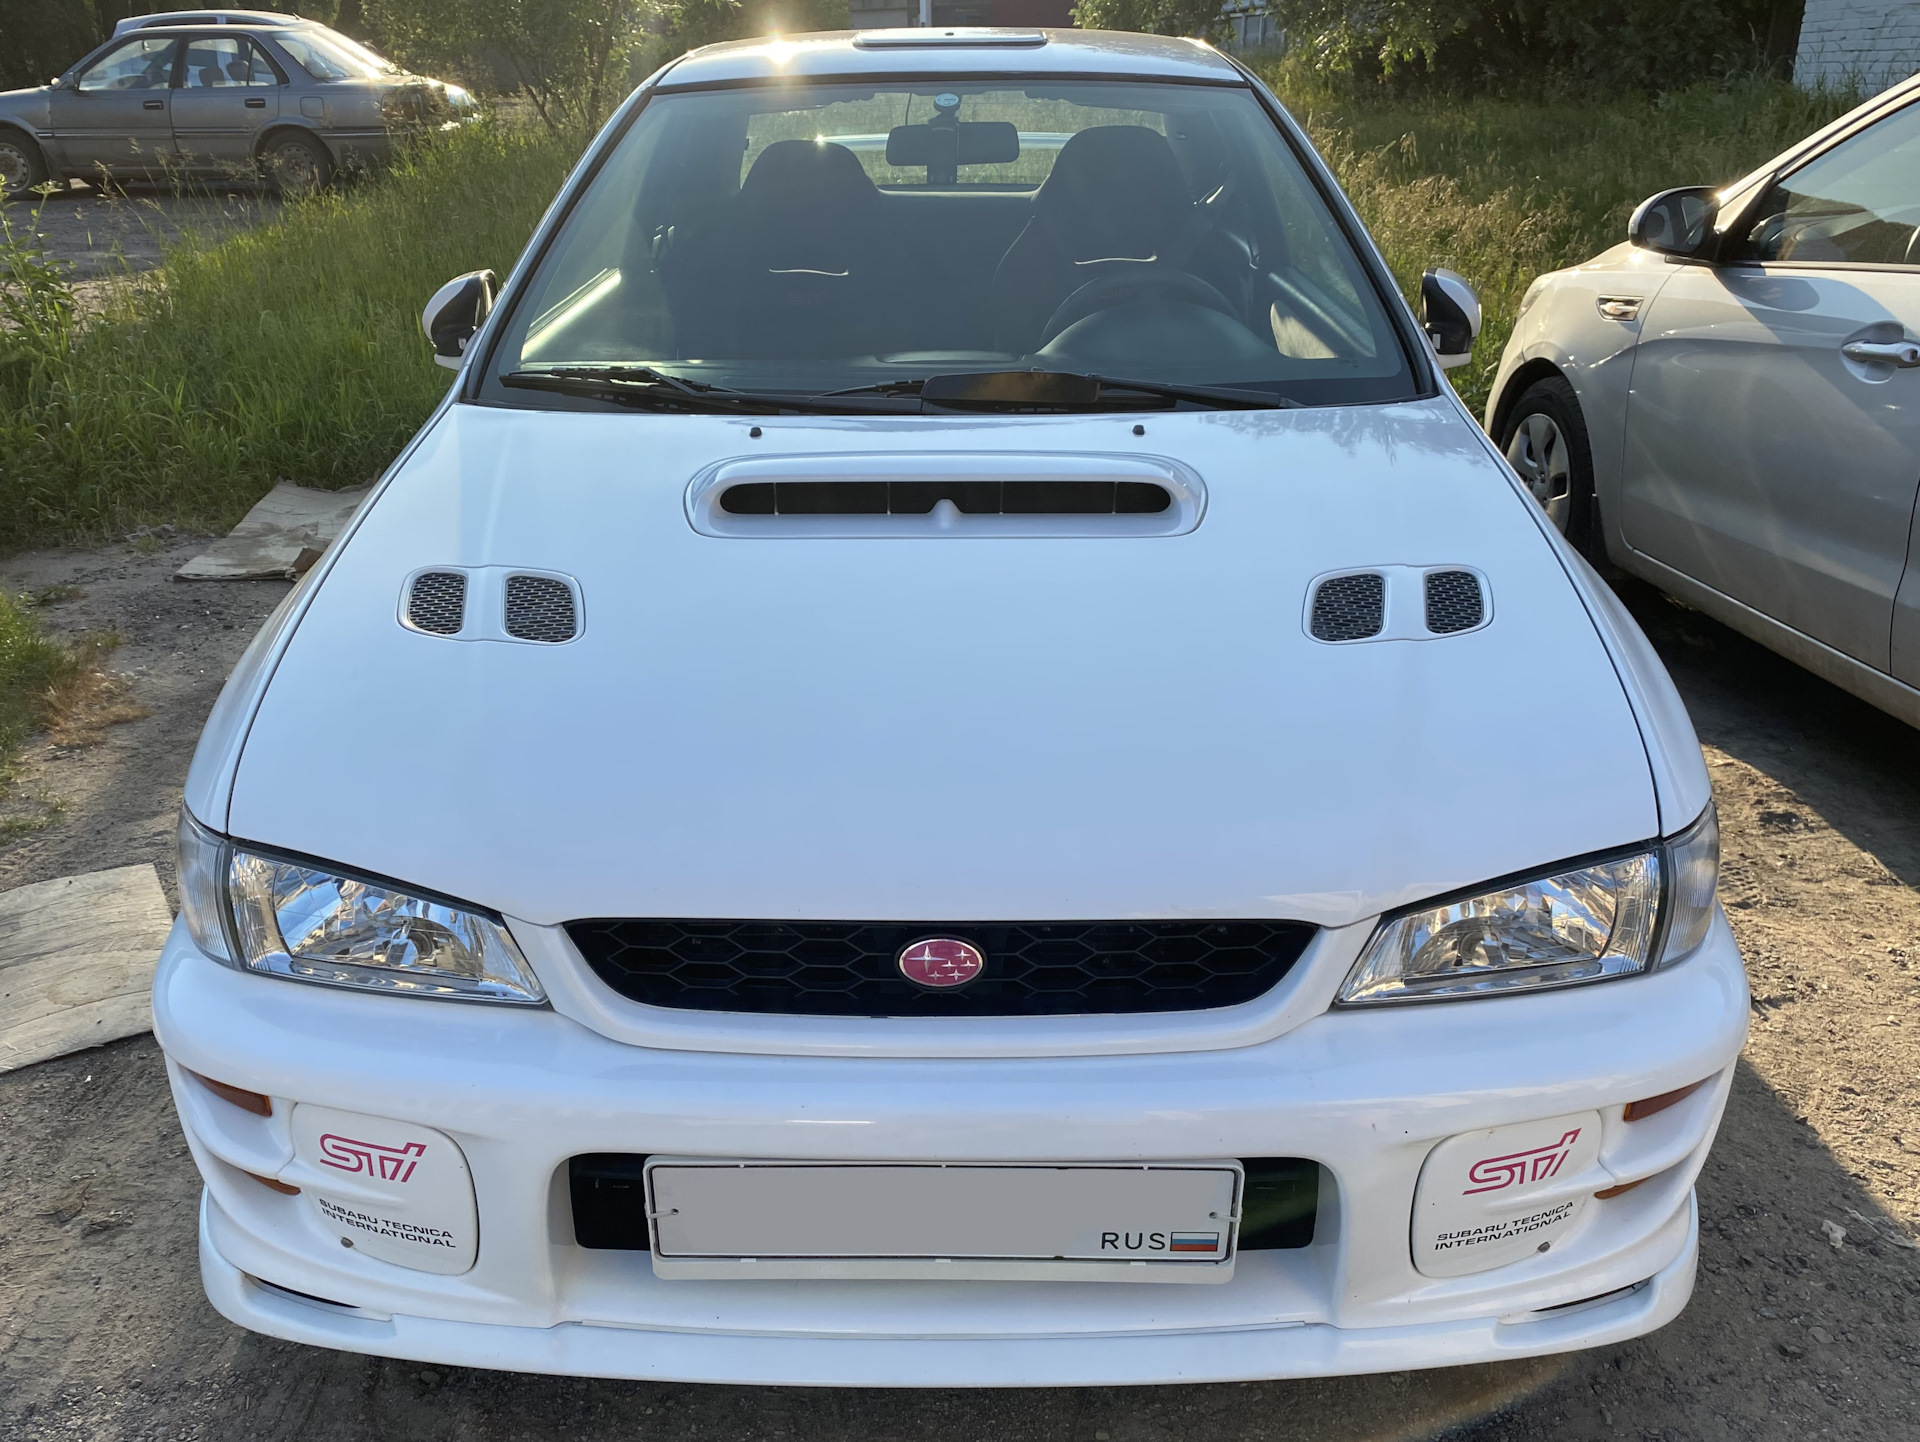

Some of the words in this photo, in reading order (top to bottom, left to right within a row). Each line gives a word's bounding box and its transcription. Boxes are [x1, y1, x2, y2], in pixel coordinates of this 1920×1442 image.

[319, 1198, 378, 1224] SUBARU
[382, 1219, 453, 1239] TECNICA
[322, 1207, 456, 1248] INTERNATIONAL
[1434, 1211, 1571, 1251] INTERNATIONAL
[1437, 1222, 1508, 1241] SUBARU
[1512, 1201, 1574, 1227] TECNICA
[1101, 1231, 1166, 1250] RUS
